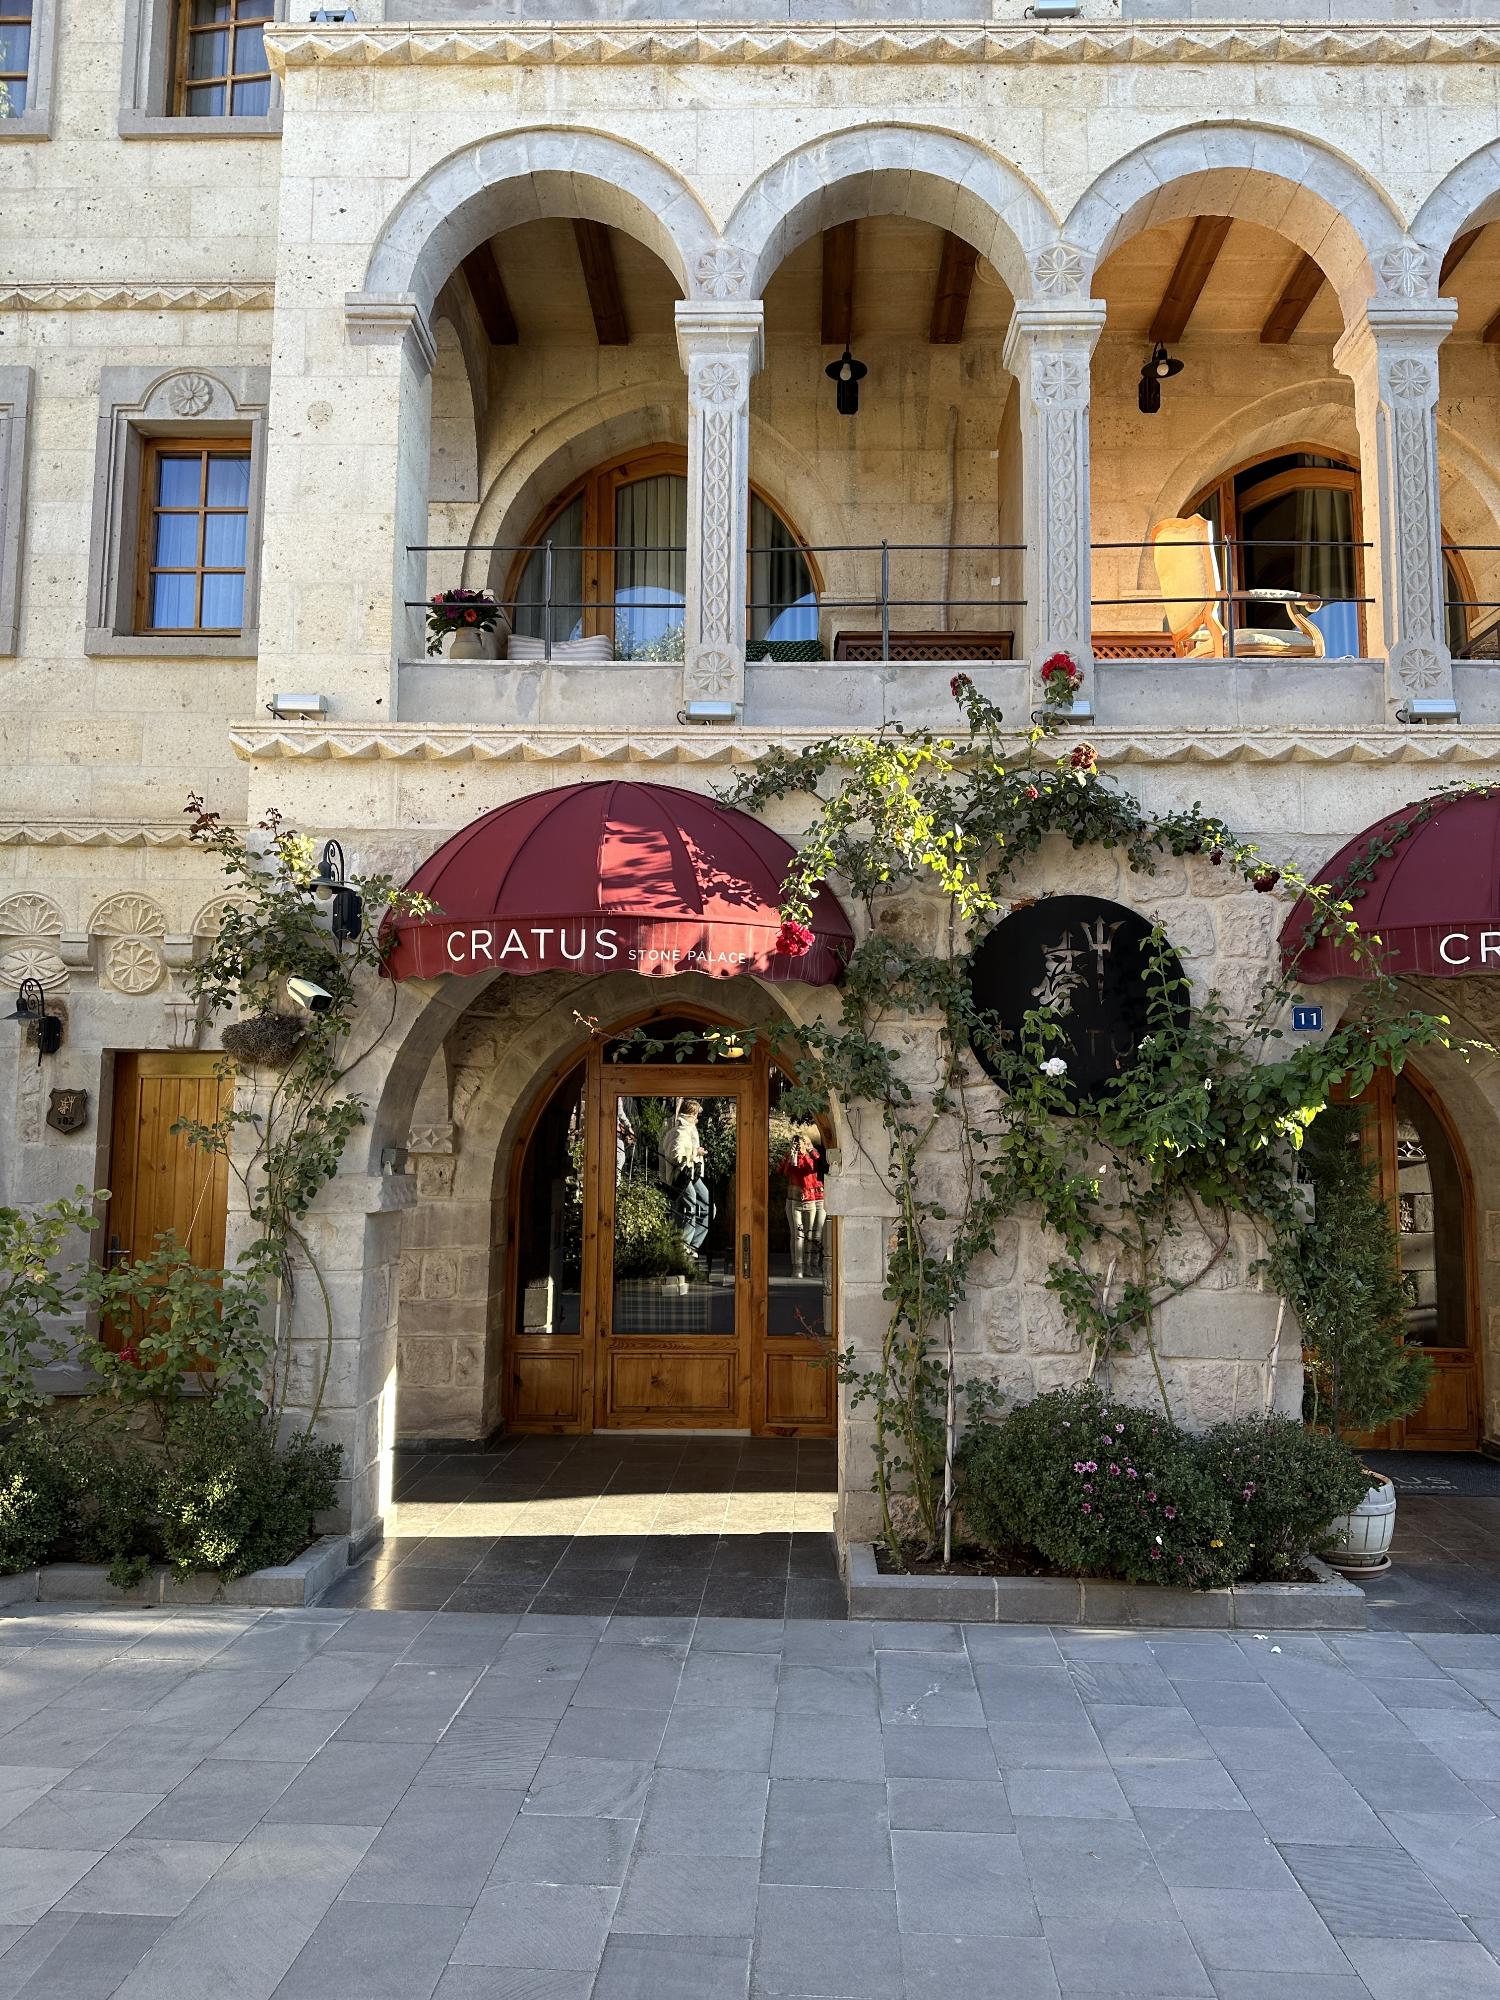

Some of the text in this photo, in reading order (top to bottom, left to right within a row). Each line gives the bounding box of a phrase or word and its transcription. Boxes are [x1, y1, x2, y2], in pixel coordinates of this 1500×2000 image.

[447, 928, 746, 964] CRATUS STONE PALACE
[1298, 1011, 1318, 1026] 11
